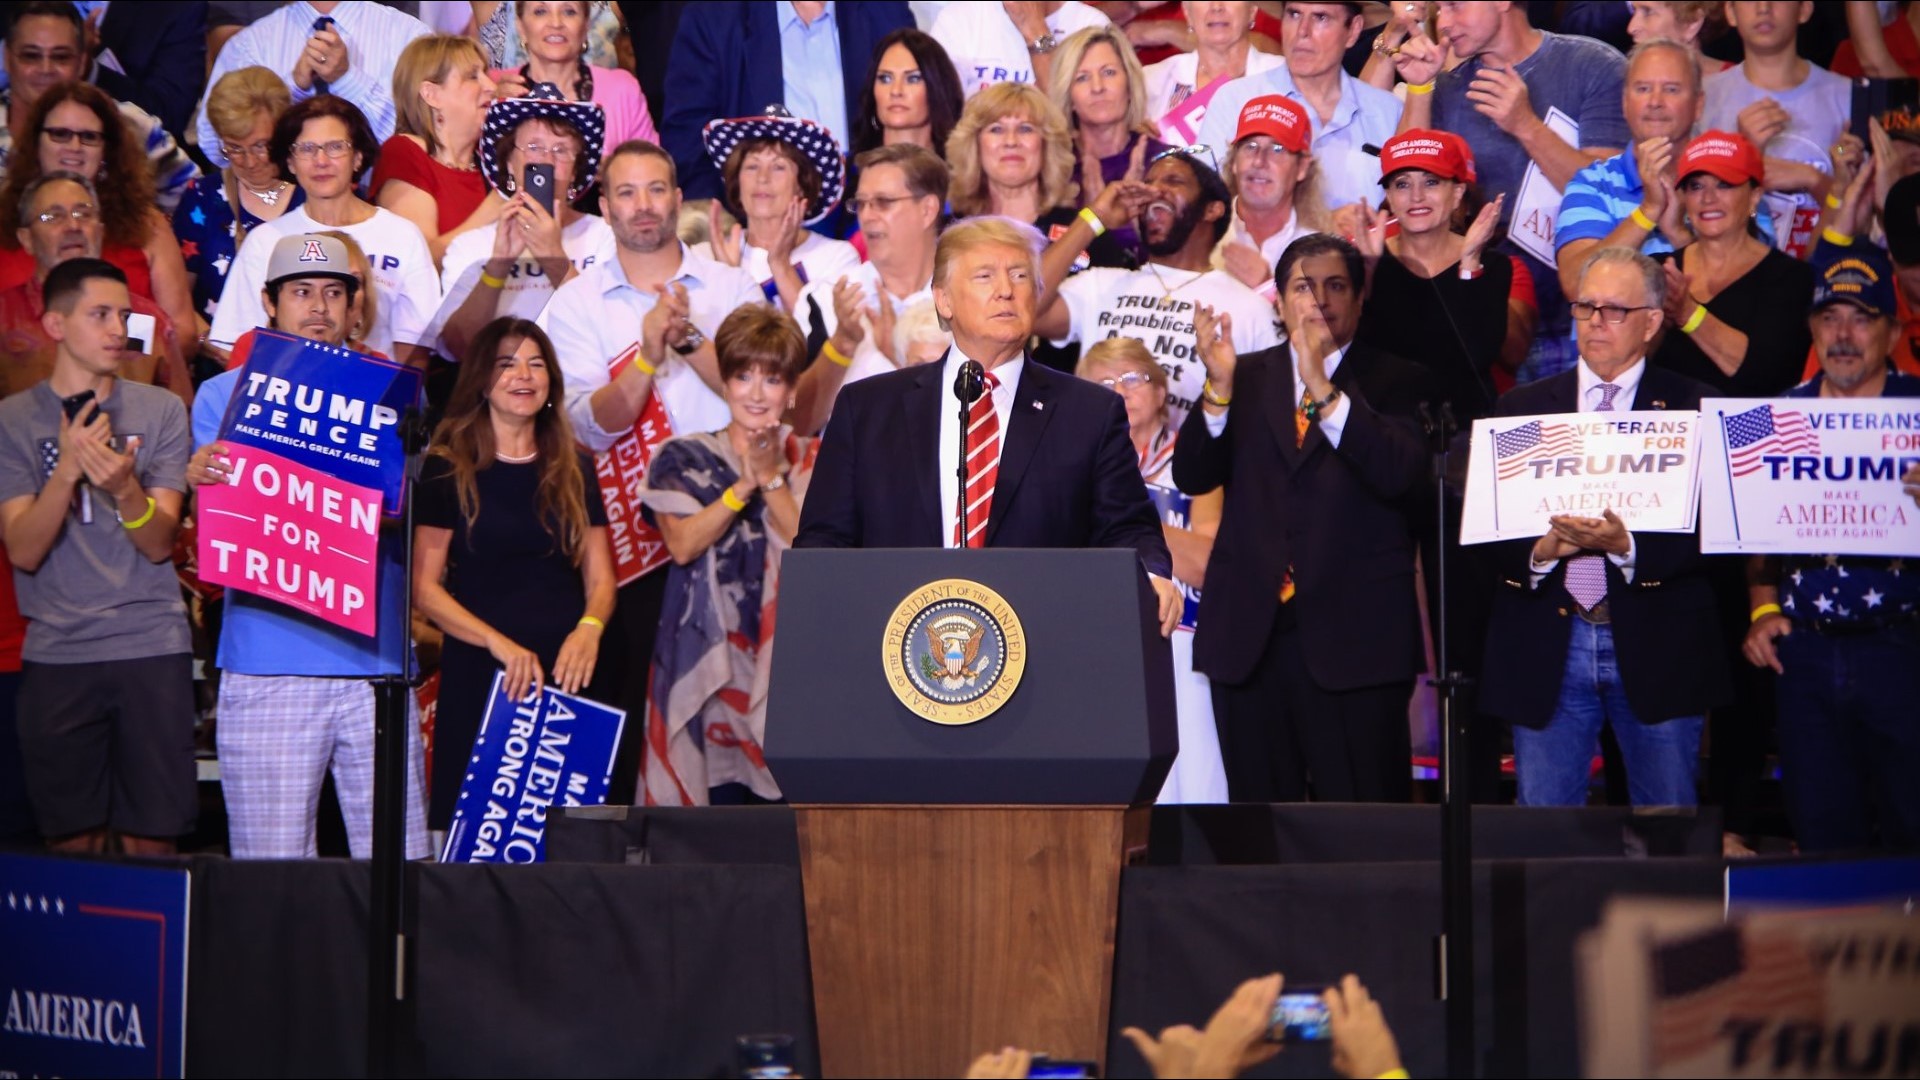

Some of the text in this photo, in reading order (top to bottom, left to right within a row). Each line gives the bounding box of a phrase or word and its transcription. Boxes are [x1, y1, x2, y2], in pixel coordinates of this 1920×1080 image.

[1409, 139, 1444, 150] AMERICA
[300, 239, 328, 262] A
[1117, 295, 1193, 314] TRUMP
[1098, 311, 1197, 335] Republica
[1153, 335, 1198, 363] Not
[246, 372, 398, 431] TRUMP
[244, 403, 378, 452] PENCE
[1577, 421, 1689, 436] VETERANS
[235, 424, 380, 468] MAKE AMERICA GREAT AGAIN!
[1643, 435, 1686, 450] FOR
[1528, 453, 1687, 480] TRUMP
[206, 456, 379, 536] WOMEN
[1583, 480, 1619, 491] MAKE
[1824, 490, 1861, 501] MAKE
[1535, 491, 1663, 514] AMERICA
[1776, 504, 1908, 526] AMERICA
[262, 513, 321, 555] FOR
[602, 486, 634, 566] AGAIN
[1796, 527, 1889, 539] GREAT AGAIN!
[210, 539, 366, 616] TRUMP
[888, 584, 1021, 718] SEAL OF THE PRESIDENT OF THE UNITED STATES
[491, 690, 543, 799] STRONG
[2, 987, 146, 1049] AMERICA
